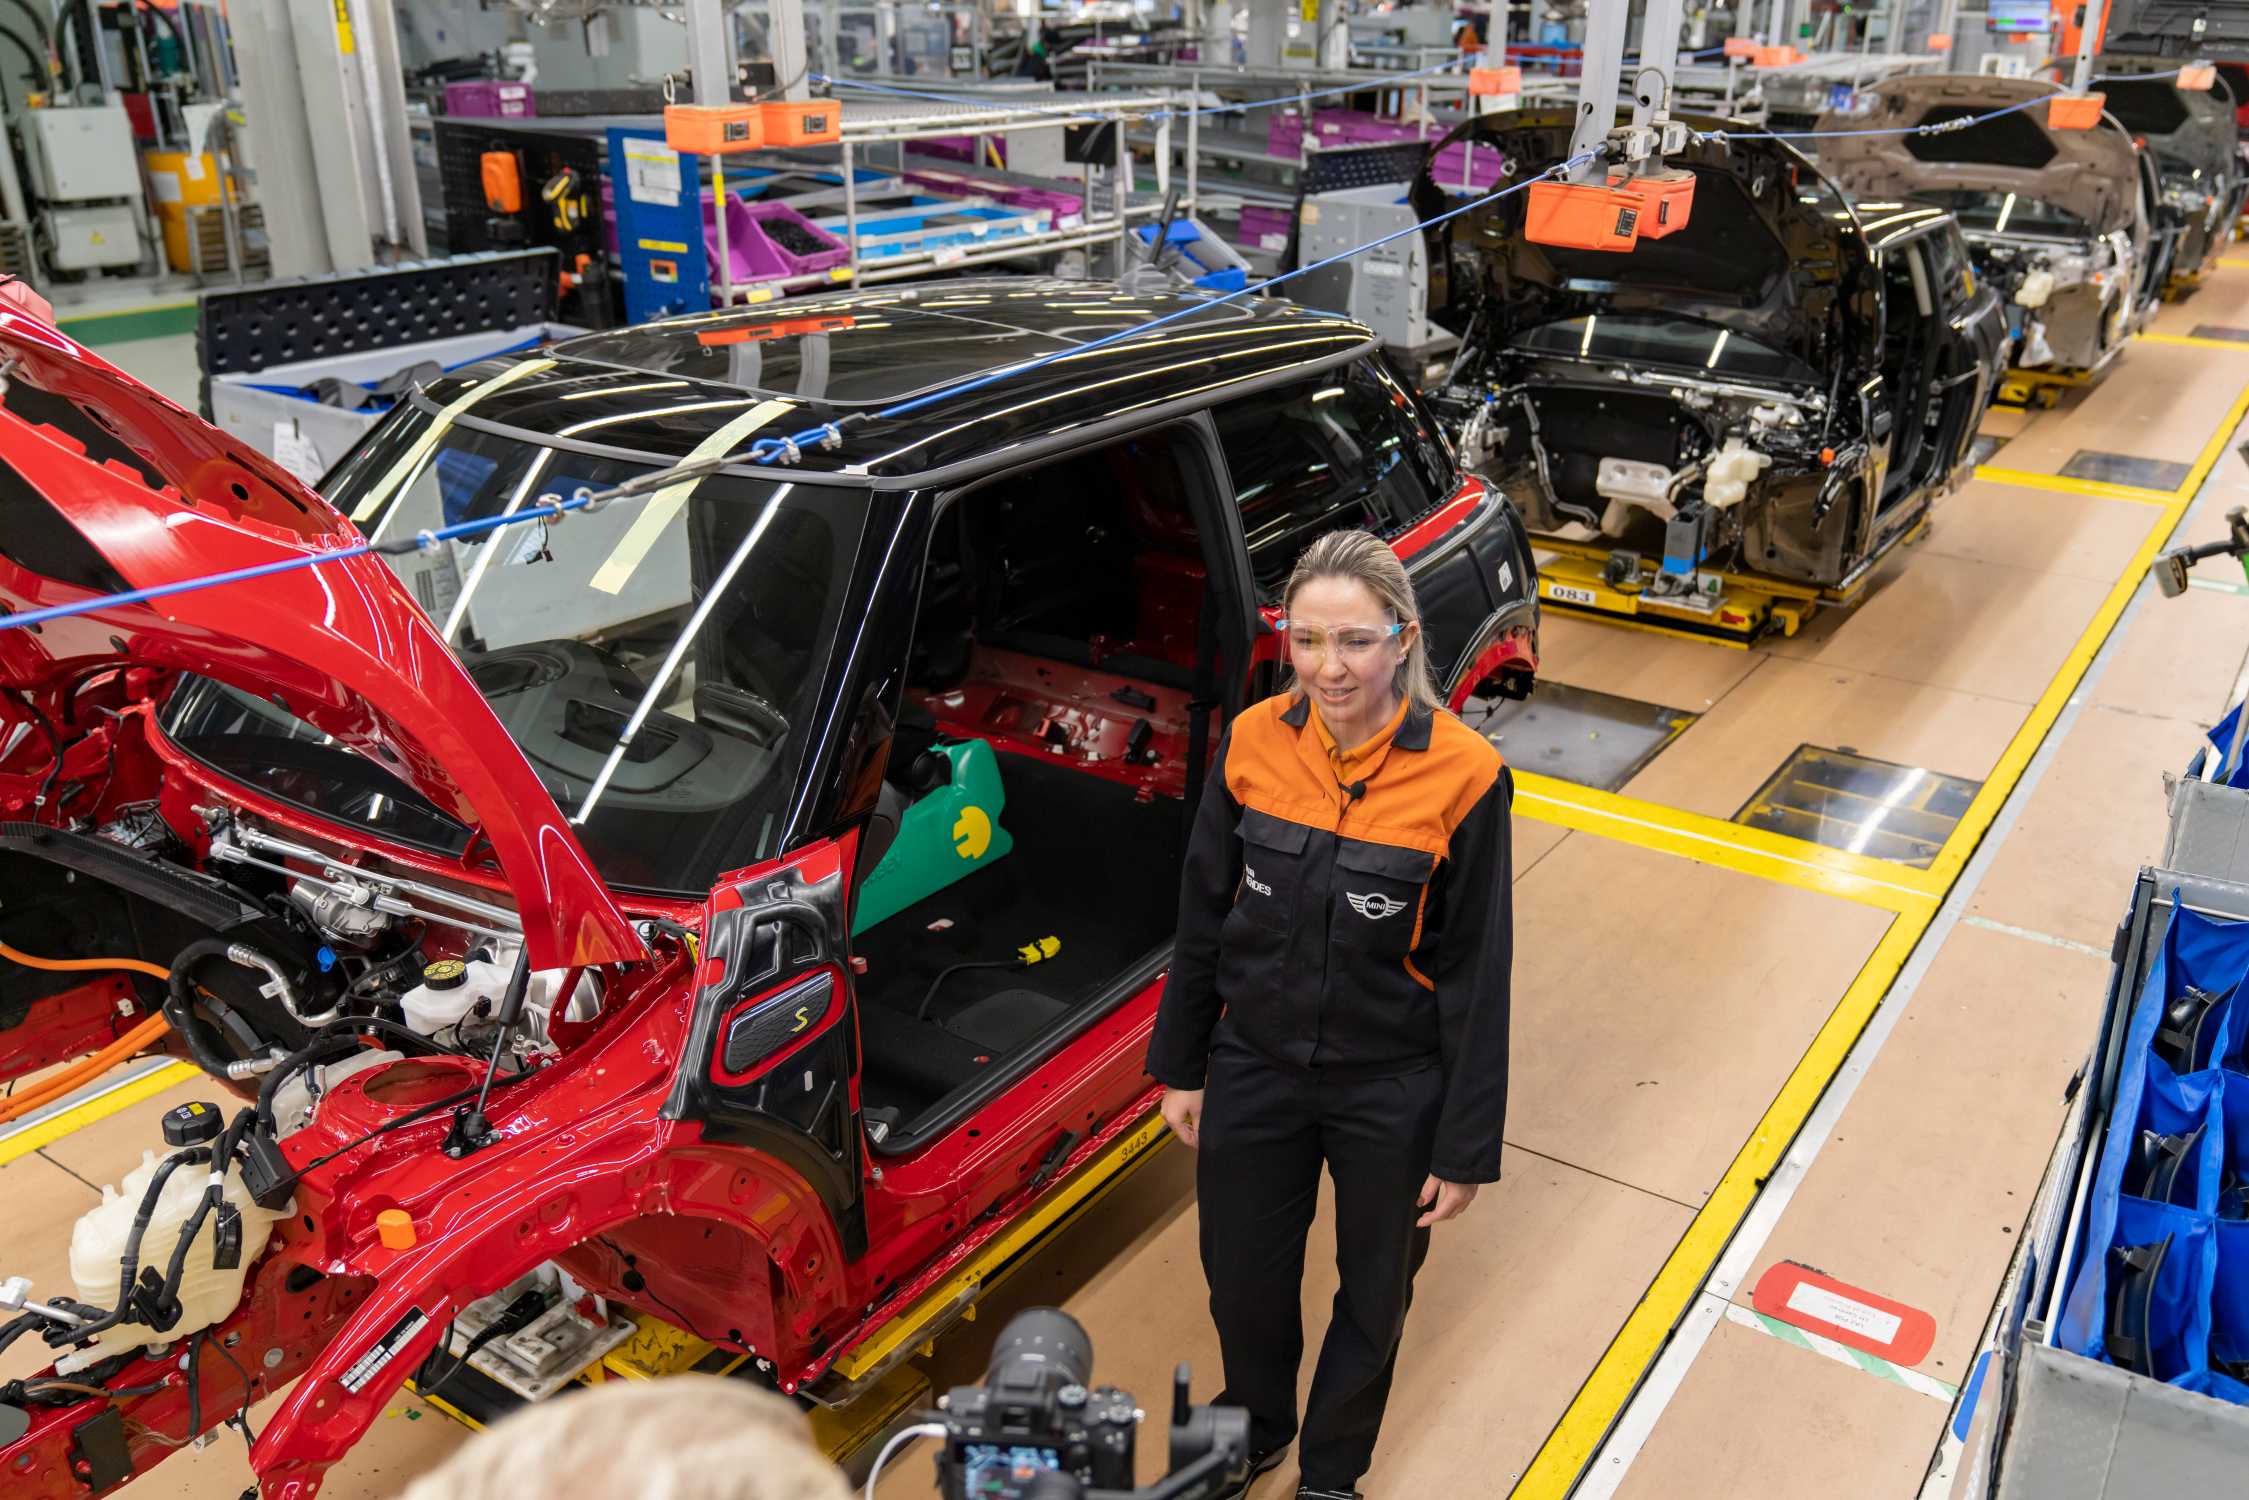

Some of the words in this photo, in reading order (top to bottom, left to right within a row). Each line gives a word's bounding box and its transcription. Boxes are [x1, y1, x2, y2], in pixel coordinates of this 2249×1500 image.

[1552, 586, 1591, 602] 083
[1366, 901, 1386, 910] MINI
[790, 1006, 809, 1033] S
